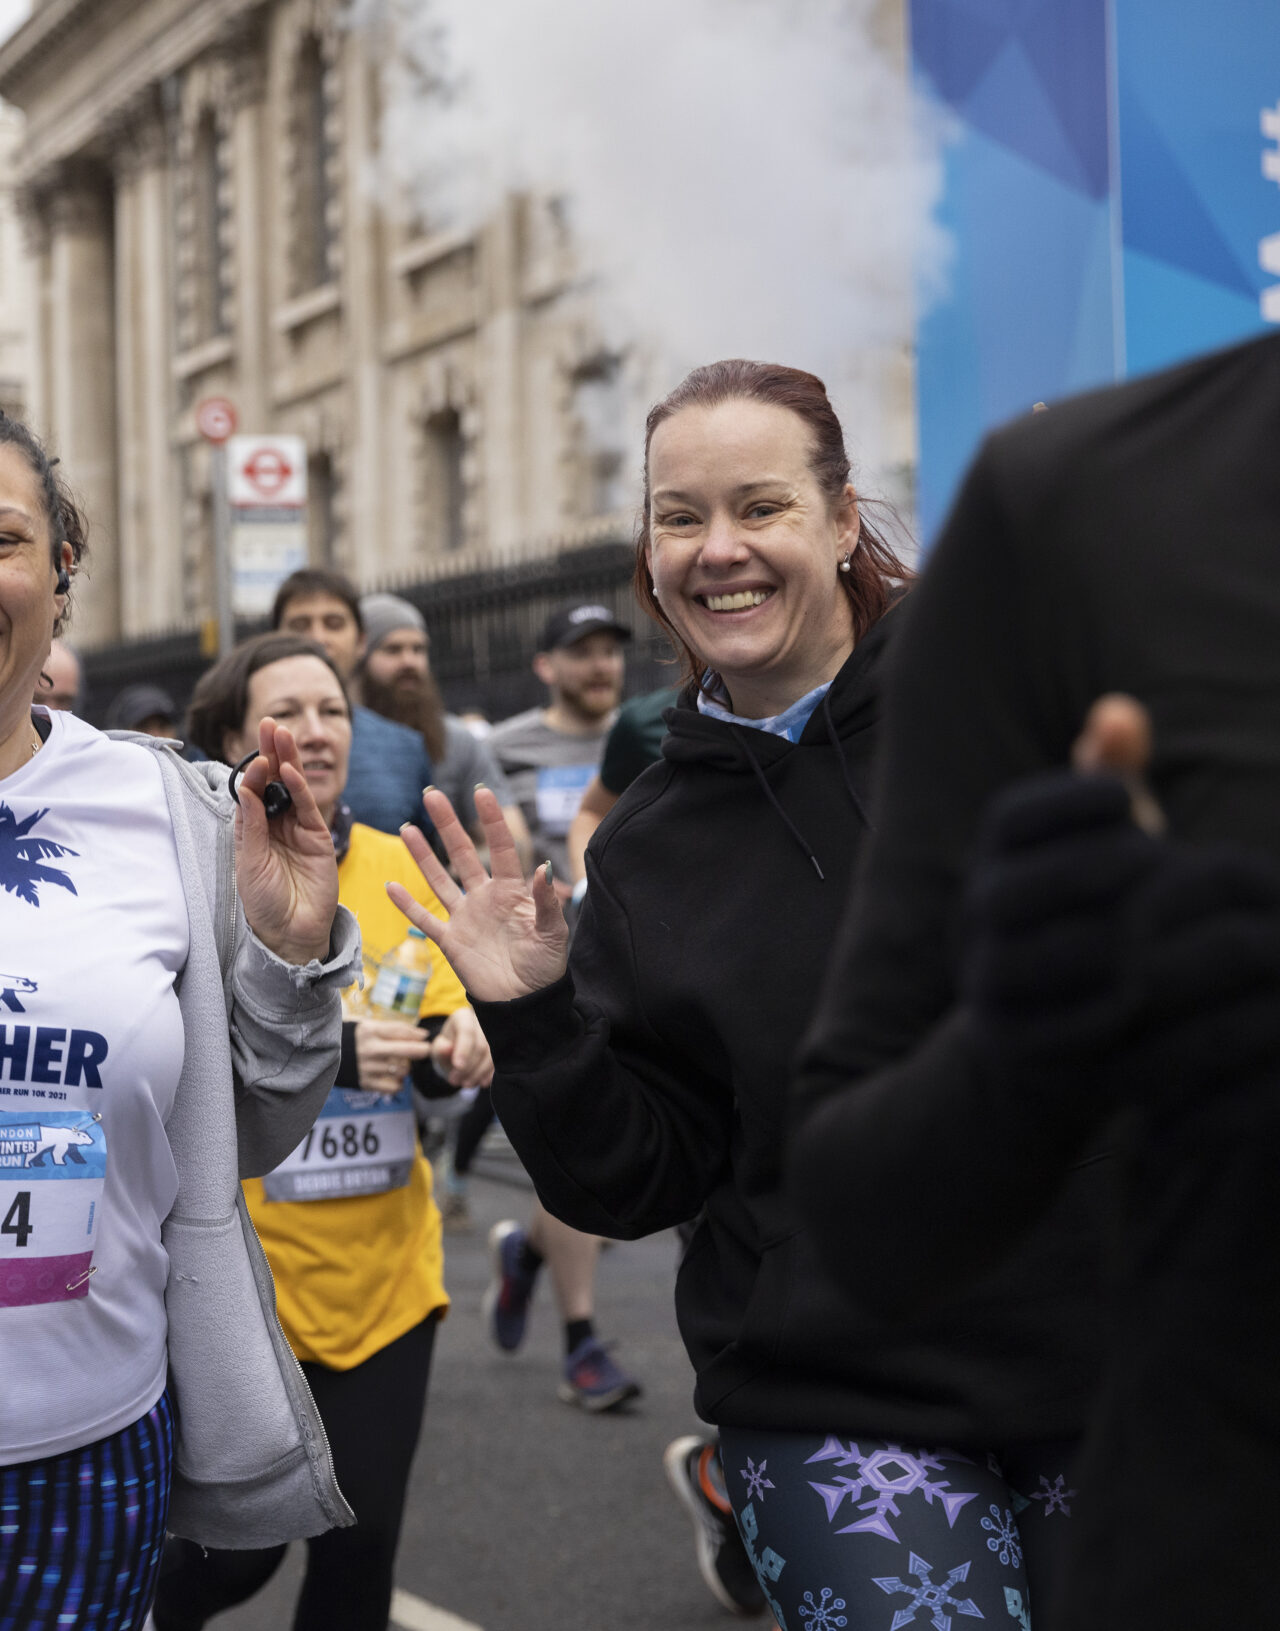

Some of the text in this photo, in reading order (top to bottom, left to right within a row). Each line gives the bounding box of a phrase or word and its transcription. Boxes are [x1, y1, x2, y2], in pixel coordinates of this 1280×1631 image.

[13, 1088, 30, 1097] RUN
[31, 1089, 46, 1098] 10K
[48, 1091, 68, 1100] 2021
